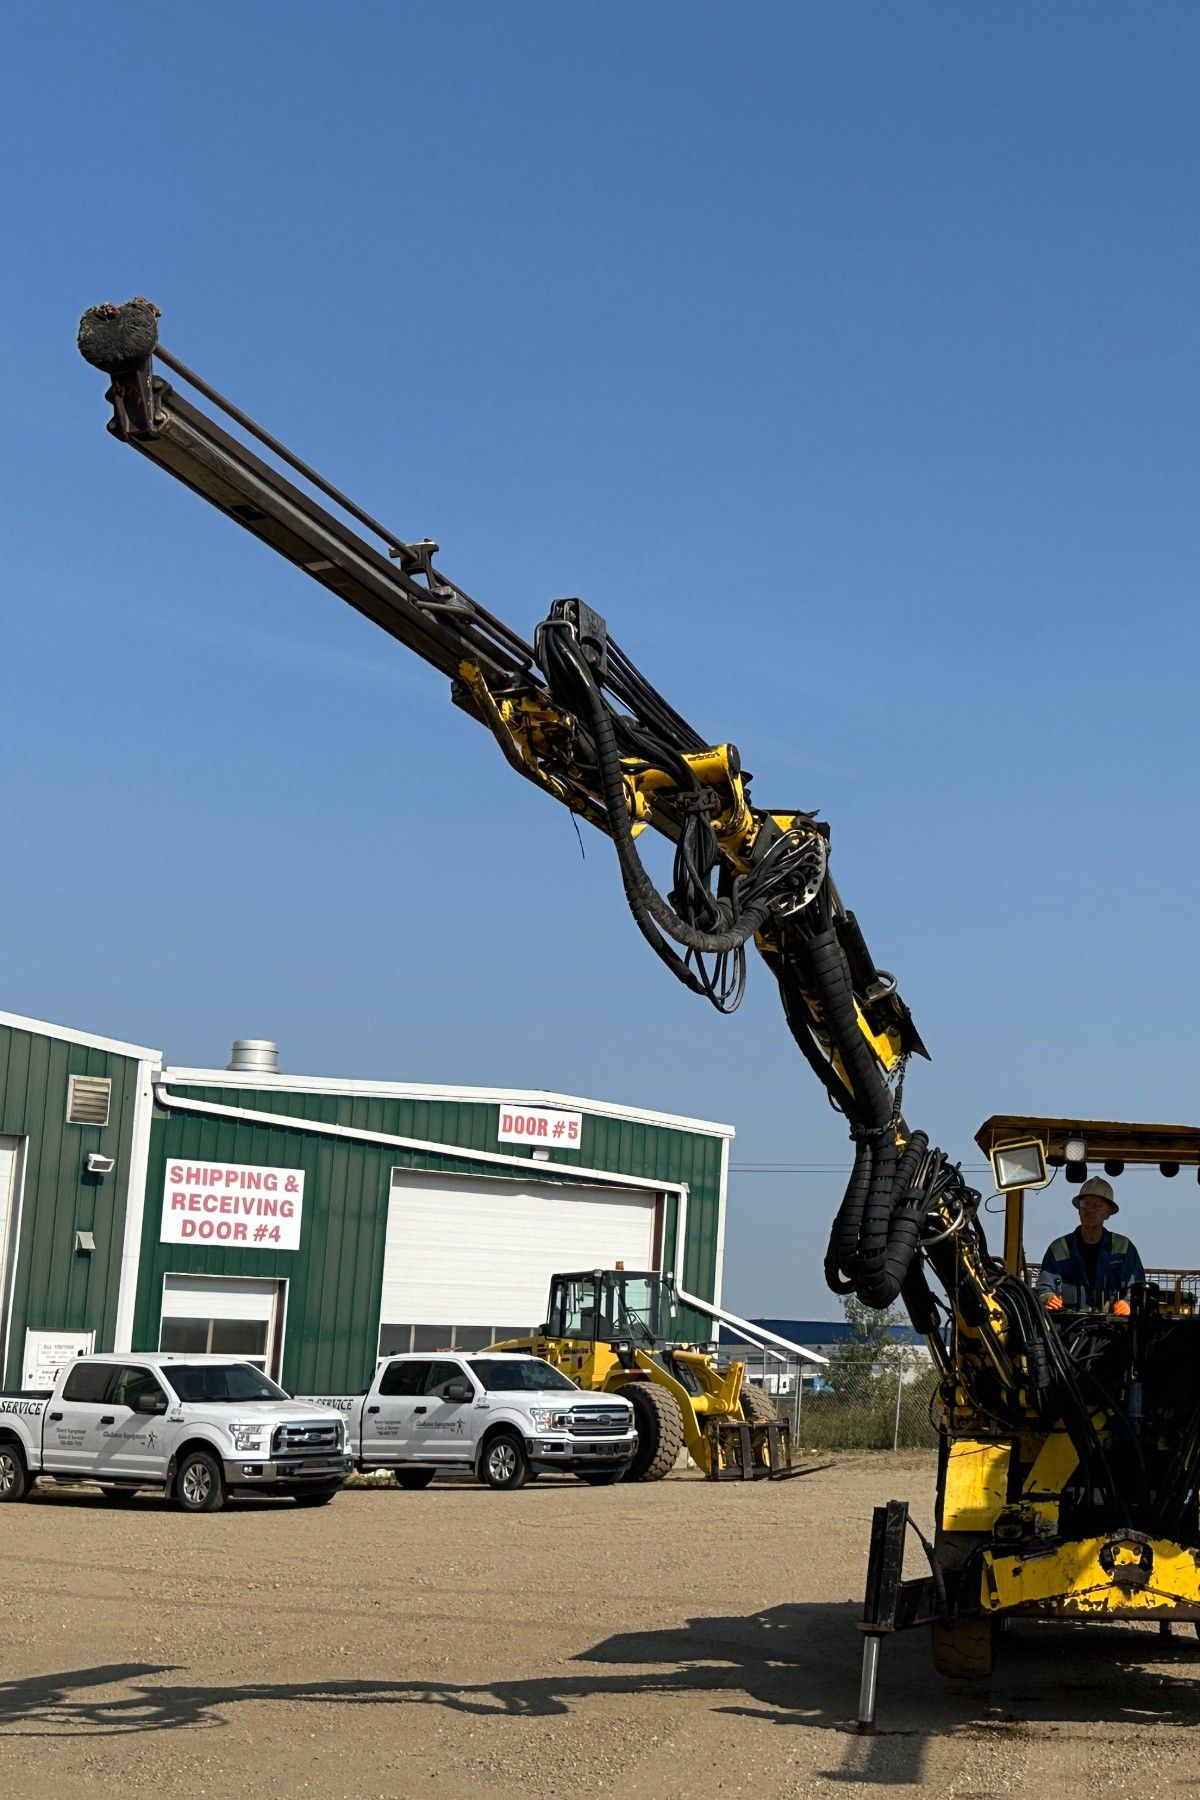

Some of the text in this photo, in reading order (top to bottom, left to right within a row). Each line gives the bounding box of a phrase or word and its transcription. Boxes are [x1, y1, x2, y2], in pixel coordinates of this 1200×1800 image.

[502, 1114, 548, 1137] DOOR
[169, 1165, 299, 1193] SHIPPING &
[171, 1191, 294, 1218] RECEIVING
[181, 1219, 282, 1243] DOOR #4
[1, 1400, 43, 1415] SERVICE
